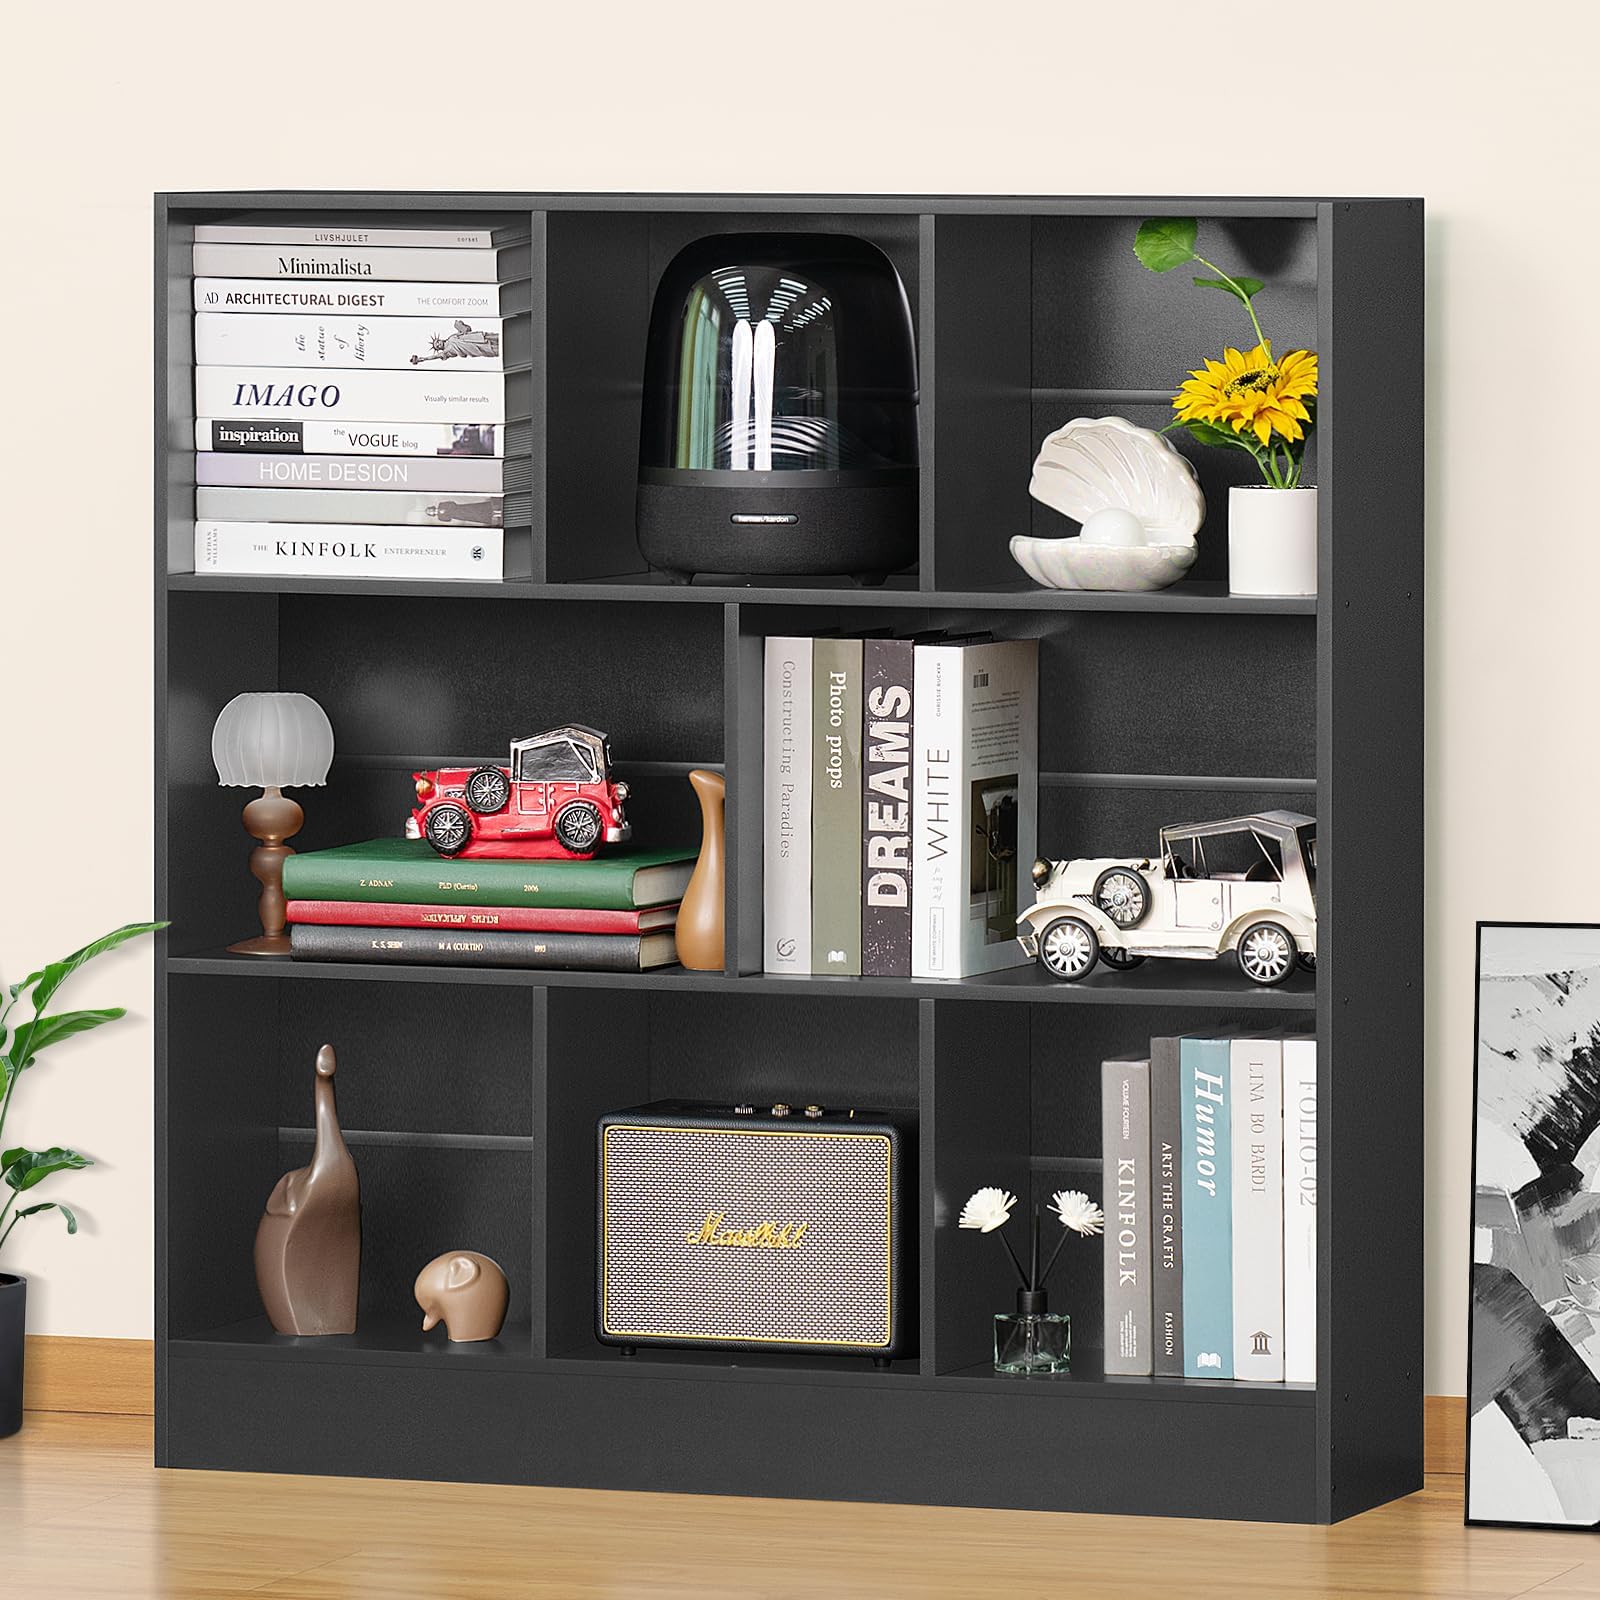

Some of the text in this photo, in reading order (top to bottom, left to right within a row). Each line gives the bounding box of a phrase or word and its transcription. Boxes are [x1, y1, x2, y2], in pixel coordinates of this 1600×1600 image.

[314, 234, 369, 242] LIVSHJULET
[278, 257, 372, 275] Minimalista
[204, 292, 386, 306] AD ARCHITECTURAL DIGEST
[417, 297, 430, 305] THE
[467, 298, 488, 306] ZOOM
[233, 384, 340, 407] IMAGO
[424, 395, 447, 404] Visually
[219, 426, 300, 446] inspiration
[348, 433, 399, 447] VOGUE
[402, 440, 418, 449] blog
[260, 462, 321, 481] HOME
[275, 541, 377, 557] KINFOLK
[826, 671, 847, 789] Photo props
[779, 660, 796, 858] Constructing Paradies
[868, 685, 912, 908] DREAMS
[927, 749, 950, 861] WHITE
[1194, 1067, 1224, 1198] Humor
[1249, 1061, 1266, 1193] LINA BO BARDI
[1161, 1142, 1174, 1269] ARTS THE CRAFTS
[1118, 1158, 1136, 1287] KINFOLK
[1164, 1311, 1173, 1356] FASHION
